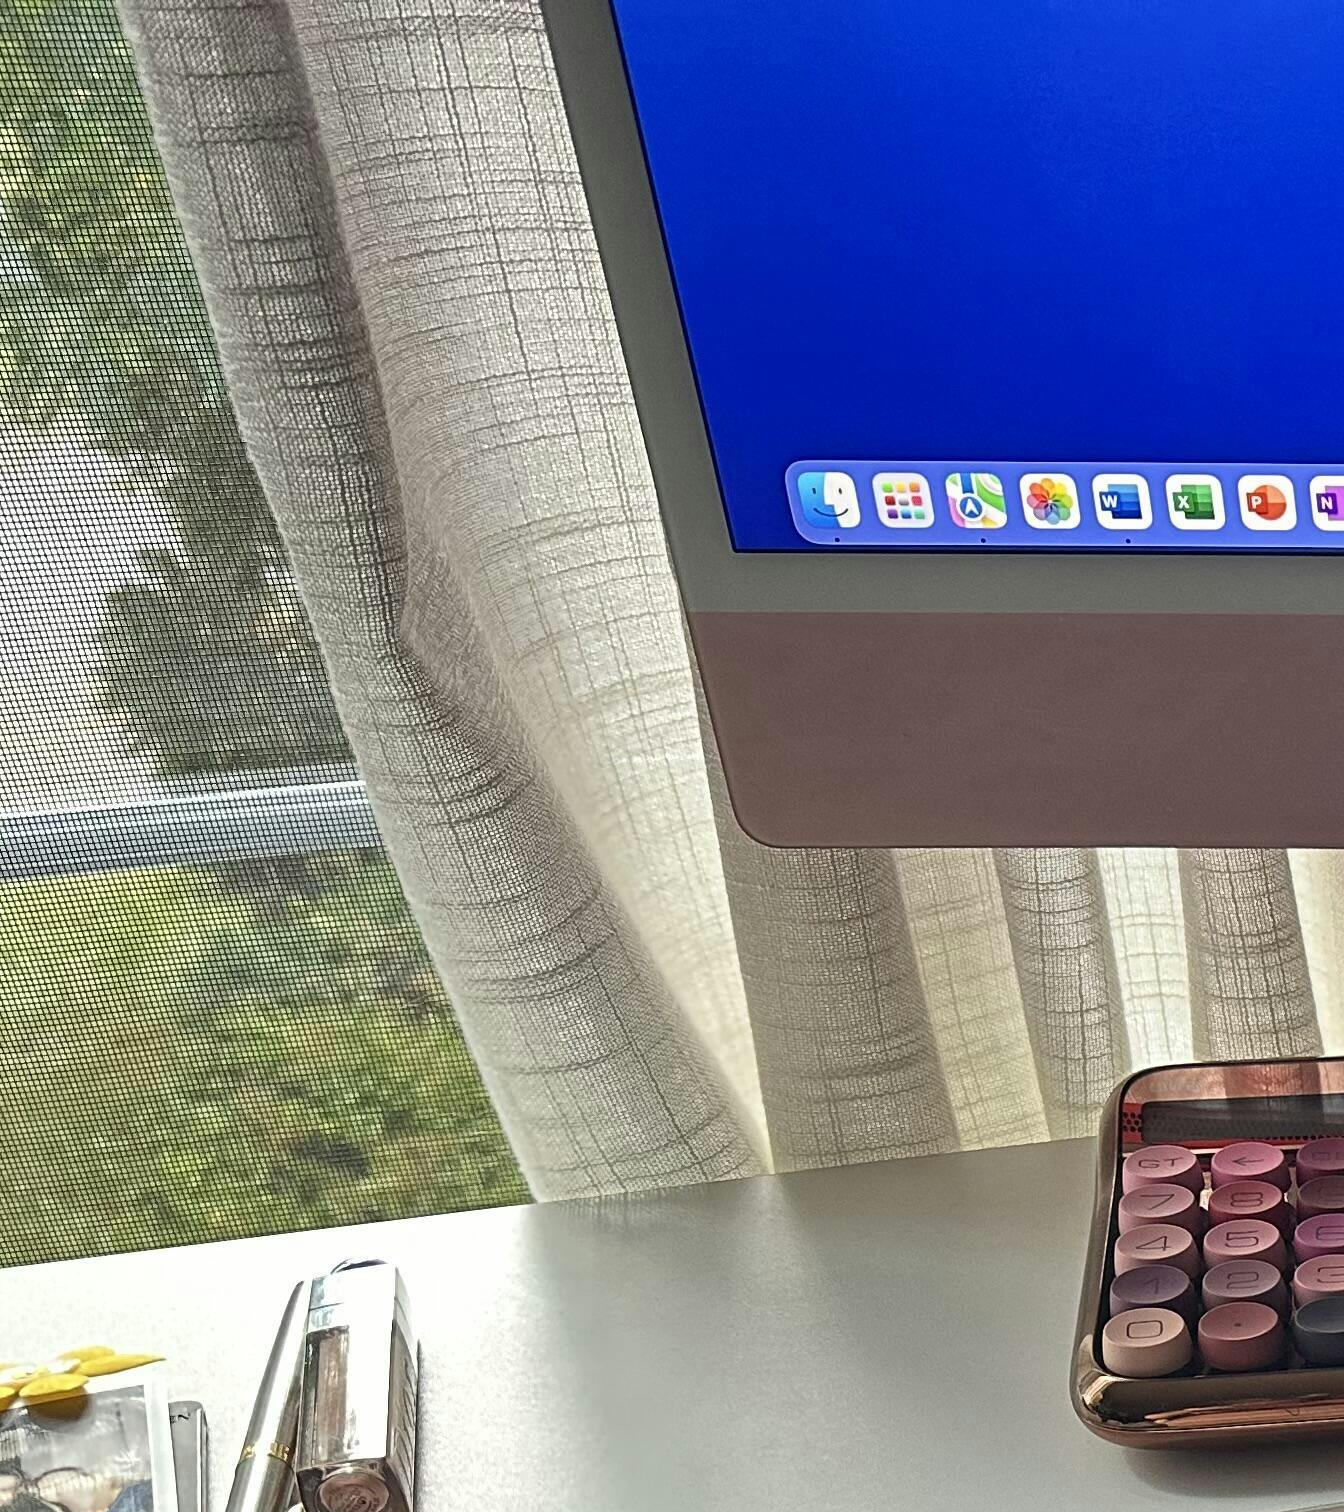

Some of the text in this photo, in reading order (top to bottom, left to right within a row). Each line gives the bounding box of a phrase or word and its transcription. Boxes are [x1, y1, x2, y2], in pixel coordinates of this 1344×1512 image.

[1138, 1157, 1184, 1169] GT
[1140, 1193, 1175, 1211] 7
[1230, 1191, 1264, 1208] 8
[1135, 1235, 1172, 1252] 4
[1225, 1230, 1260, 1248] 5
[1226, 1271, 1260, 1291] 2
[1126, 1319, 1164, 1340] 0
